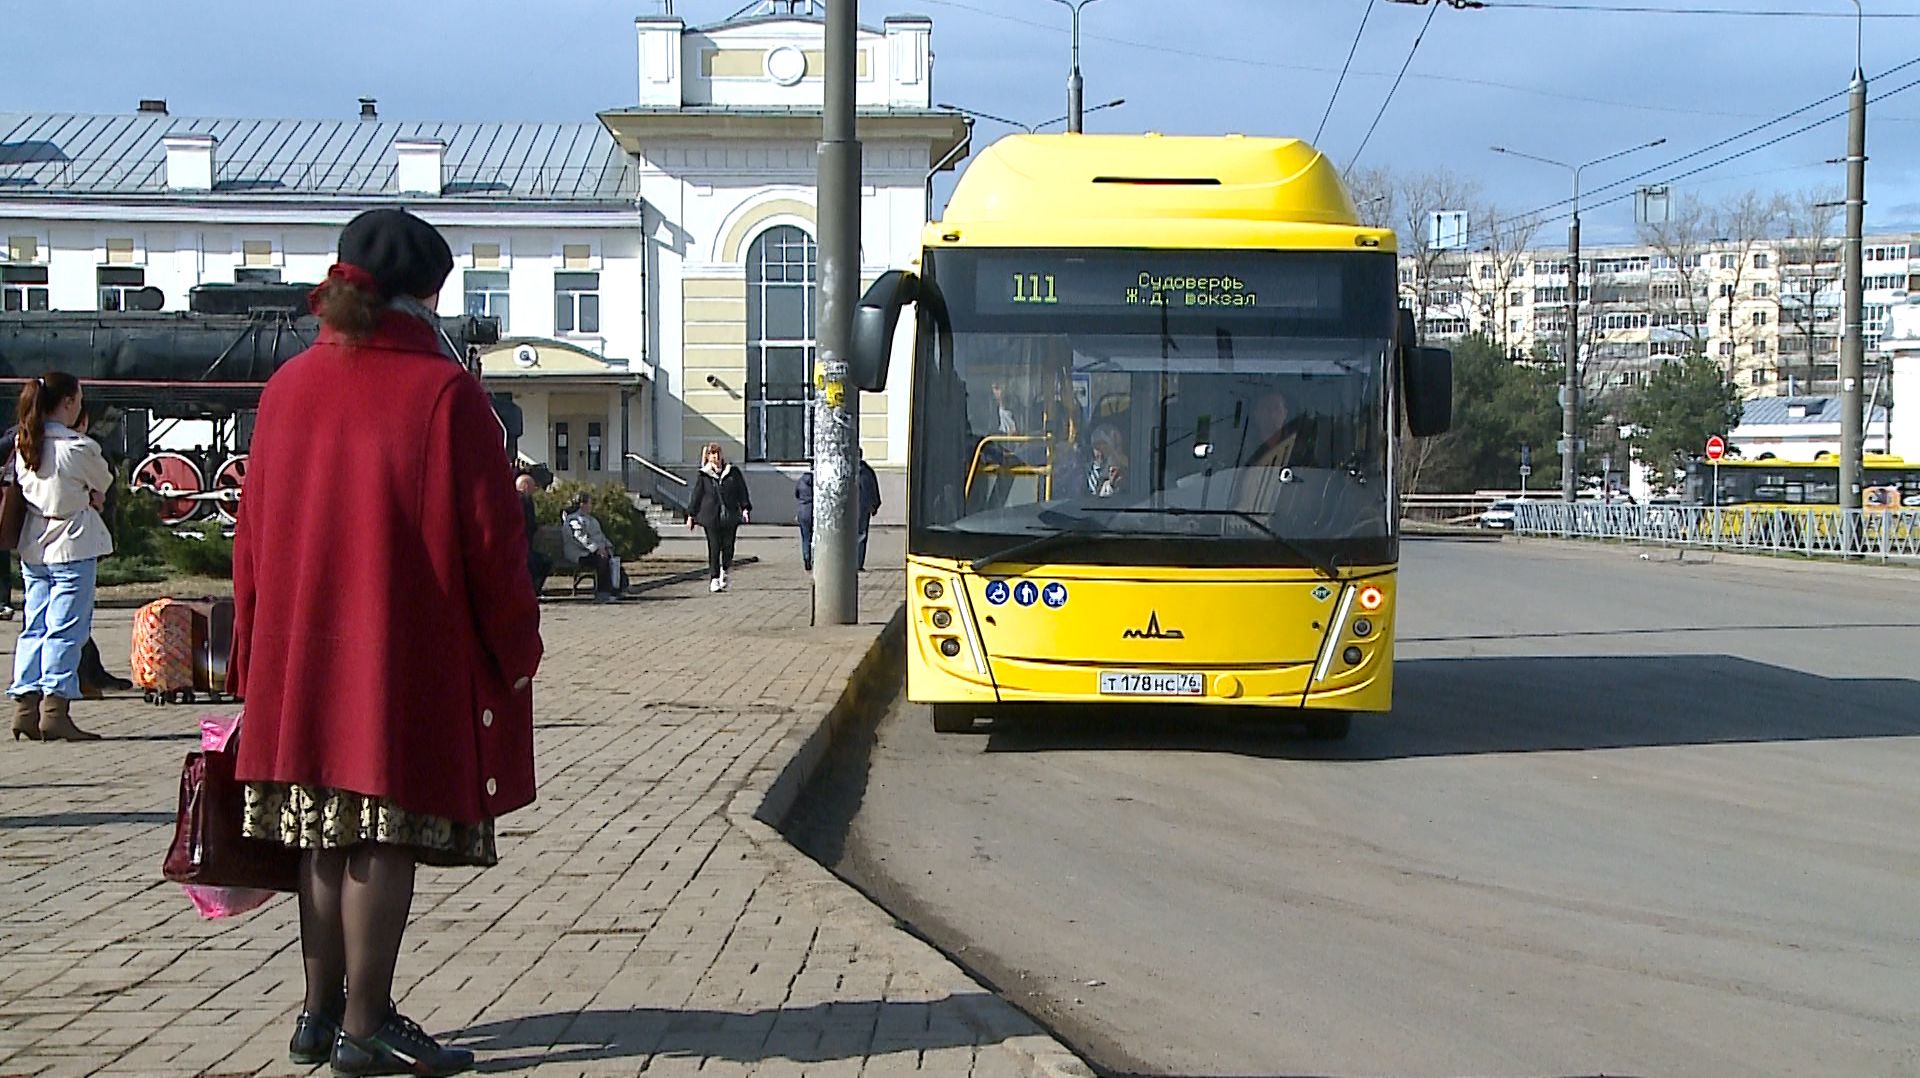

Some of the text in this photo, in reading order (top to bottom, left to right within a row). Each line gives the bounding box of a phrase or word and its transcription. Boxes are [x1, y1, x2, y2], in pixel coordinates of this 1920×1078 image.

[1013, 273, 1057, 302] 111
[1138, 272, 1244, 291] Судоверфь
[1185, 292, 1257, 305] вокзал
[1180, 675, 1197, 687] 76
